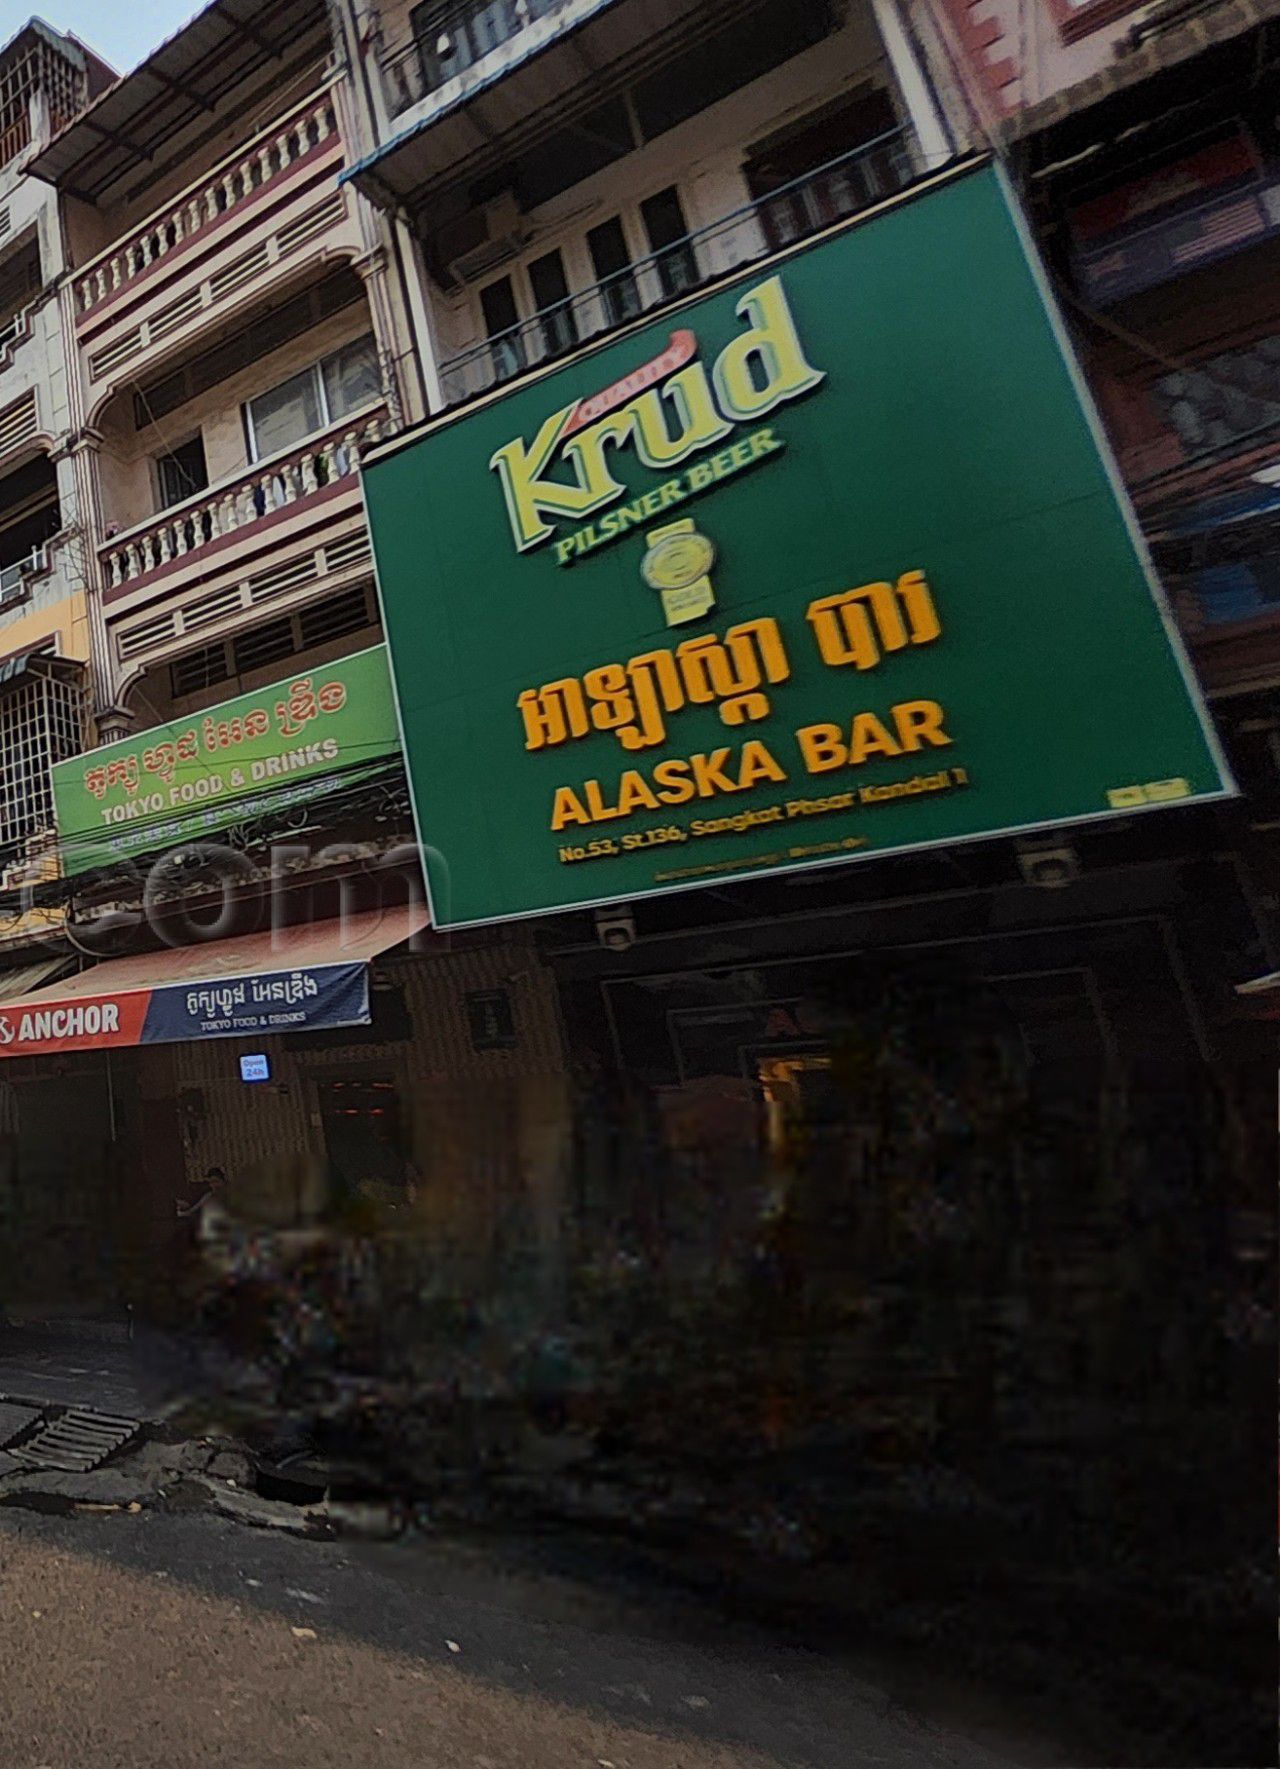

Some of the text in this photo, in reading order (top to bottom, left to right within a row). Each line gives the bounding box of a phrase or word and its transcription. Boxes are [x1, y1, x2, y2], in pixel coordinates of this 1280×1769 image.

[489, 274, 827, 553] Krud
[552, 427, 788, 568] PILSNER BEER
[100, 792, 163, 825] TOKYO
[170, 774, 223, 807] FOOD
[230, 768, 246, 788] &
[250, 738, 339, 782] DRINKS
[550, 700, 953, 831] ALASKA BAR
[18, 1003, 120, 1042] ANCHOR
[200, 1011, 307, 1032] TOKYO FOOD & DRINKS
